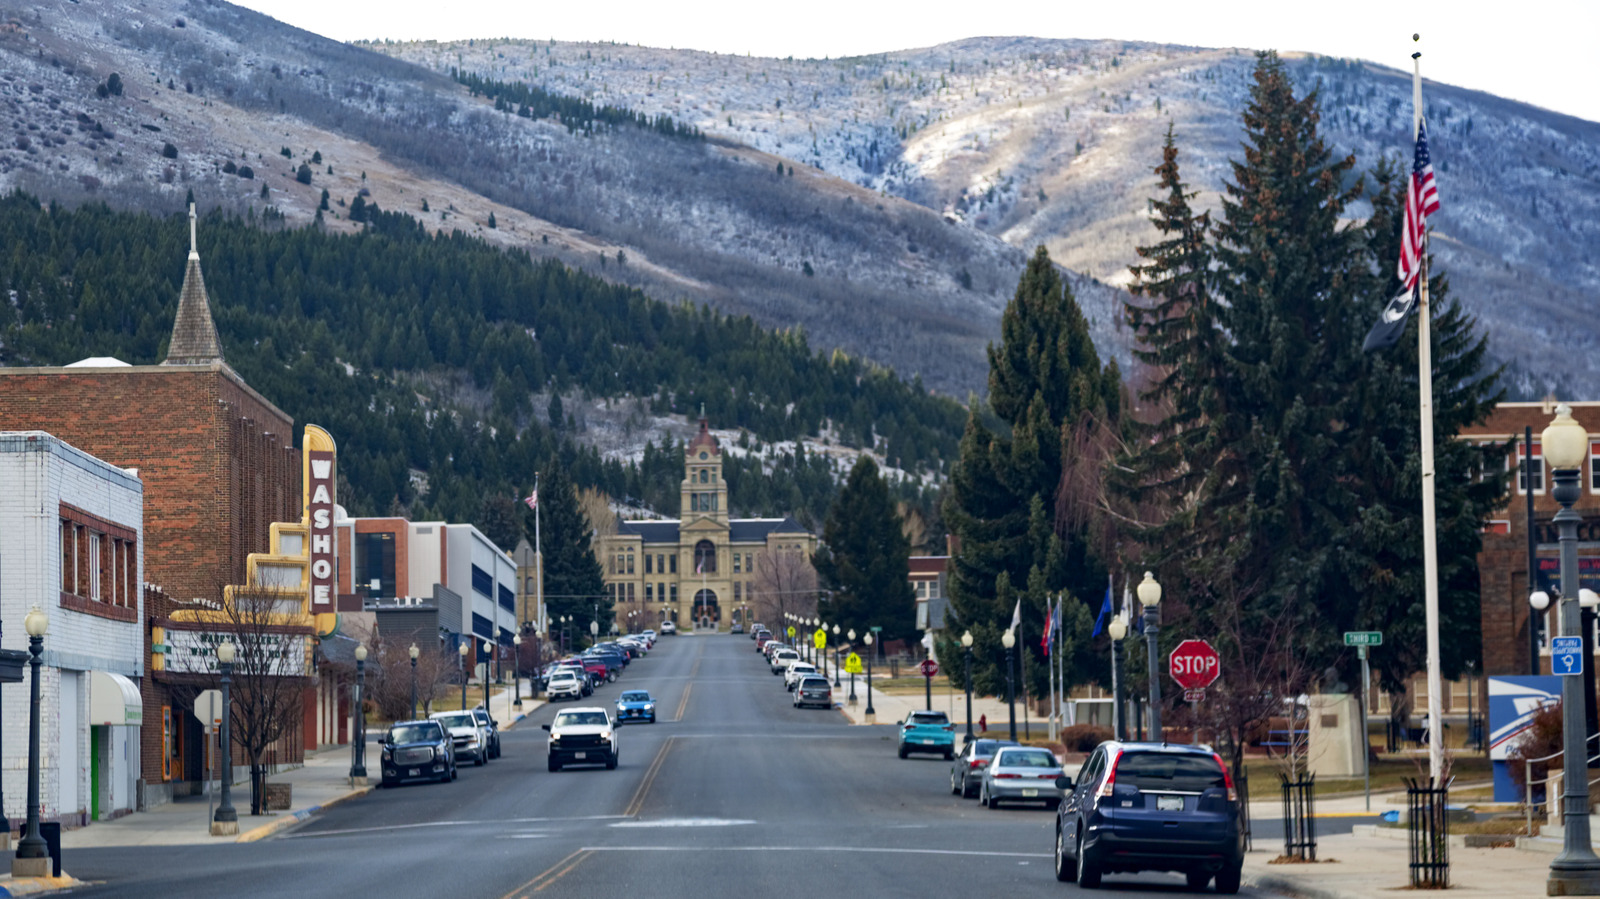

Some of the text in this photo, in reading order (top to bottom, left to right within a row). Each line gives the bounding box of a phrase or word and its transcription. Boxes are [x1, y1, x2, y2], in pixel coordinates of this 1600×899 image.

[311, 459, 332, 605] WASHOE
[241, 635, 279, 645] LER'S
[1350, 633, 1369, 643] THIRD
[921, 664, 938, 672] SOP
[1173, 655, 1217, 674] STOP
